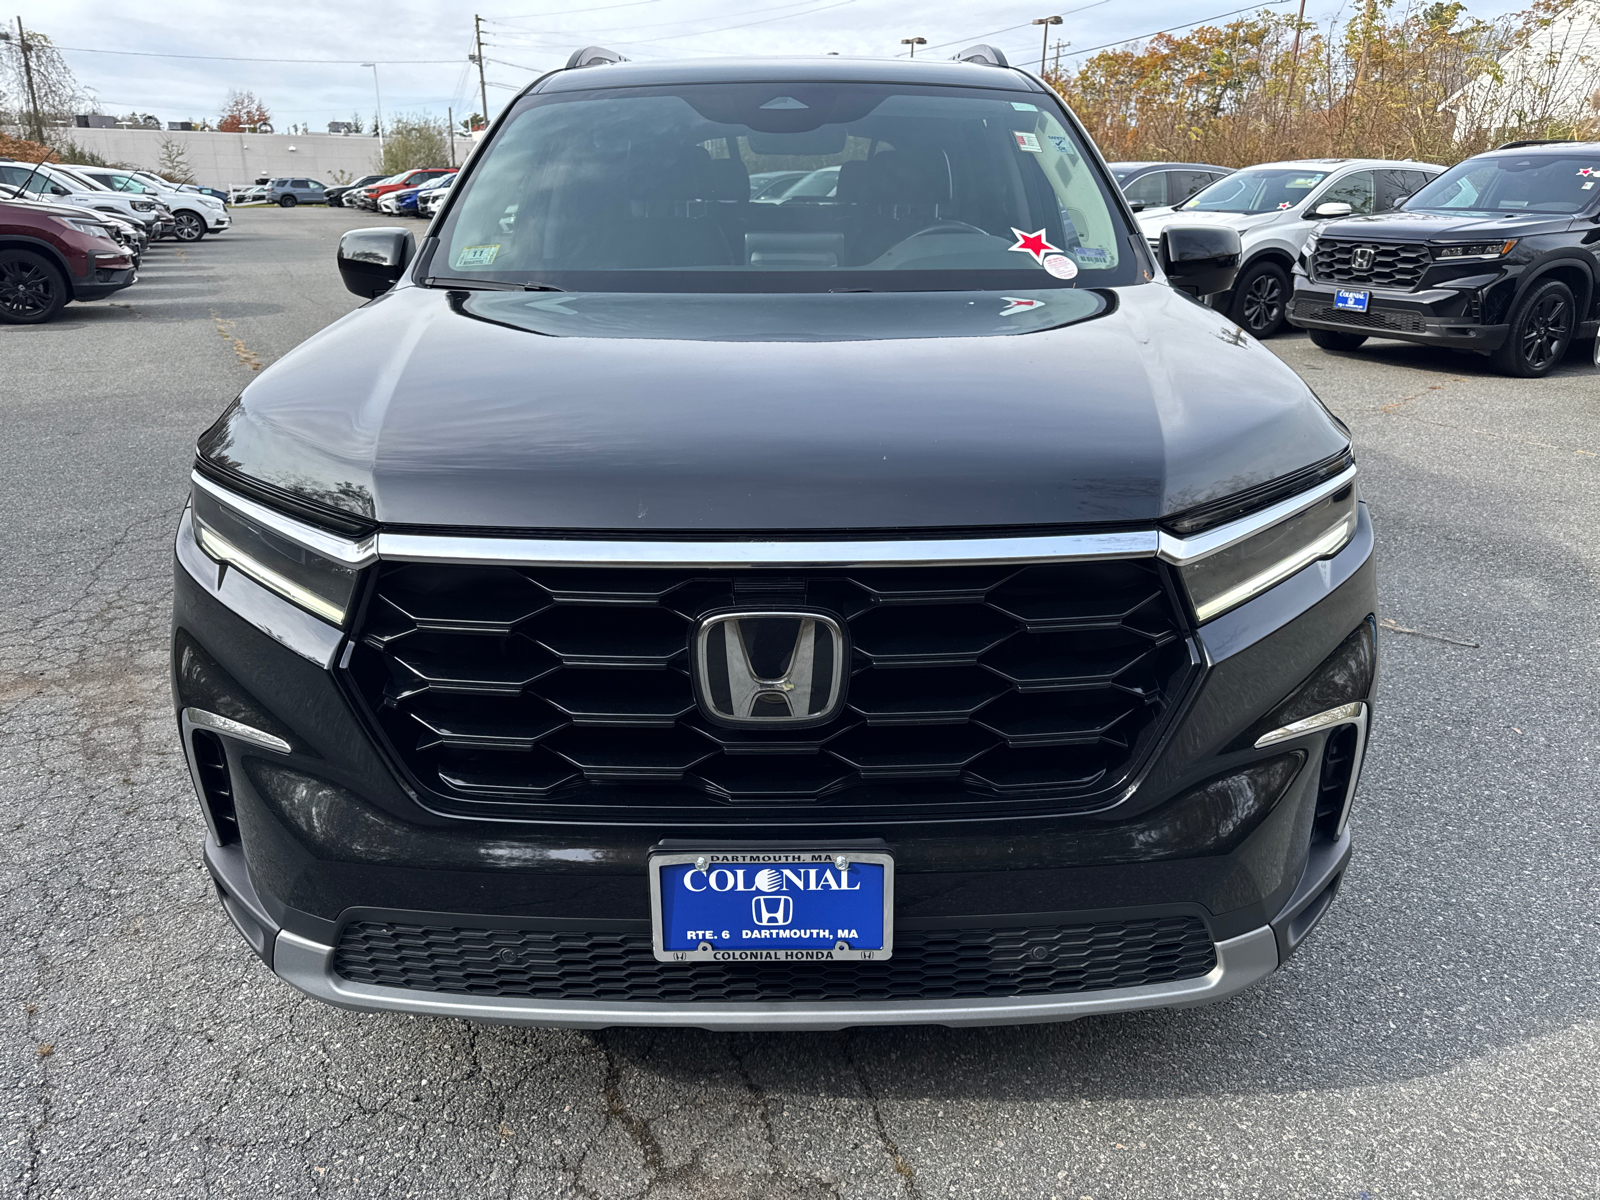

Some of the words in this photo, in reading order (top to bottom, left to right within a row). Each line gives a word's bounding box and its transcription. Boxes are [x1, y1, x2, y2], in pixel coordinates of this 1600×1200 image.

[683, 868, 860, 892] COLONIAL
[687, 930, 718, 940] RTE.
[722, 930, 730, 939] 6
[742, 929, 833, 940] DARTMOUTH,
[838, 929, 858, 939] MA
[713, 951, 783, 960] COLONIAL
[785, 951, 834, 960] HONDA
